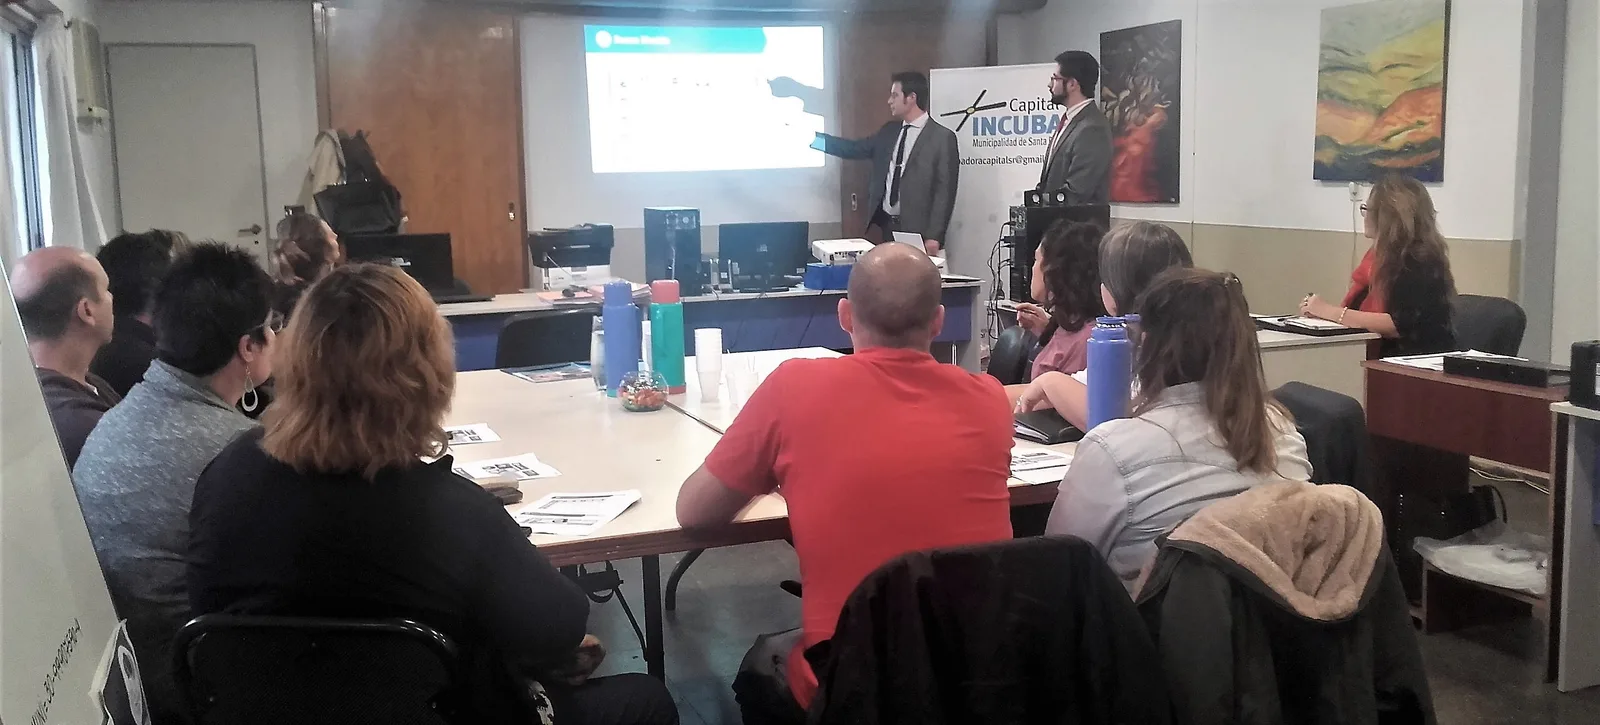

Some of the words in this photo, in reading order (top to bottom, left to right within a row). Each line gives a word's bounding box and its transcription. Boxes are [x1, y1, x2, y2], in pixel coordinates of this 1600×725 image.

[972, 113, 1060, 136] INCUBA
[972, 137, 1017, 149] Municipalidad
[1018, 136, 1027, 146] de
[1028, 137, 1047, 146] Santa
